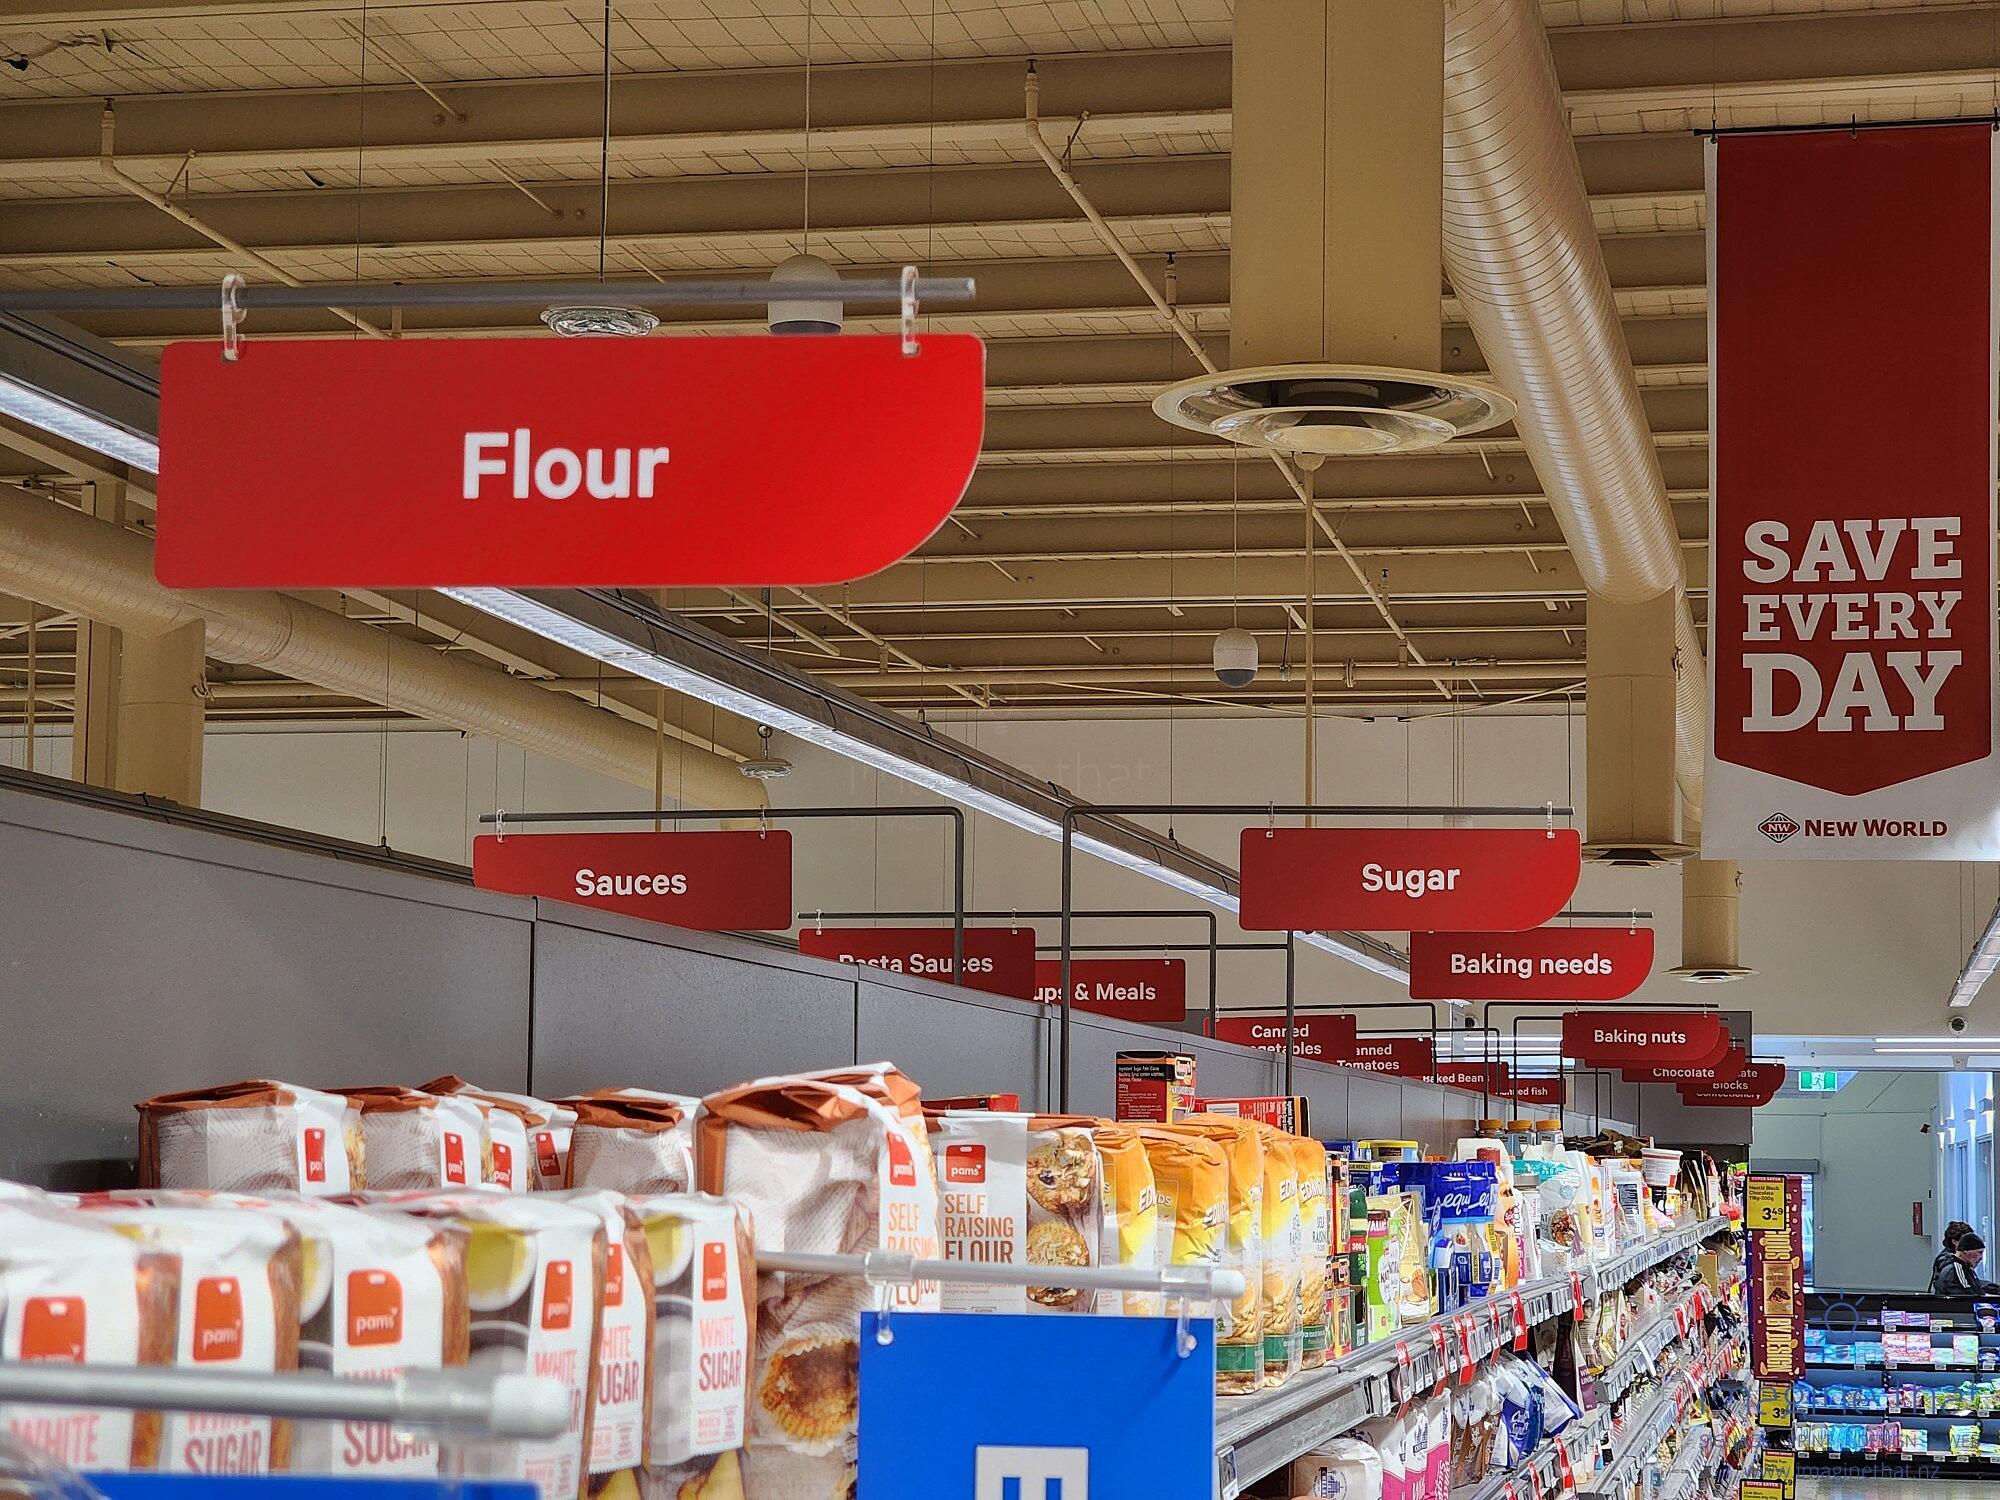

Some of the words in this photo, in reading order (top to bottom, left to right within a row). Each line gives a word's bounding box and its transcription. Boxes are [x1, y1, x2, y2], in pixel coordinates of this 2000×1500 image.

[463, 428, 670, 499] Flour
[1743, 517, 1962, 584] SAVE
[1742, 591, 1962, 641] EVERY
[1742, 650, 1962, 732] DAY
[1767, 822, 1792, 833] NW
[1804, 819, 1858, 837] NEW
[1862, 819, 1948, 837] WORLD
[575, 868, 687, 896] Sauces
[1362, 863, 1460, 898] Sugar
[839, 954, 903, 973] Psta
[1451, 953, 1532, 979] Baking
[1540, 953, 1613, 976] needs
[1074, 983, 1089, 1000] &
[1096, 982, 1156, 1000] Meals
[1355, 1043, 1392, 1056] anned
[1594, 1029, 1647, 1046] Baking
[1651, 1030, 1686, 1043] nuts
[1458, 1073, 1490, 1083] Bean
[1653, 1068, 1715, 1078] Chocolate
[1531, 1087, 1548, 1096] fish
[951, 1164, 979, 1177] pams
[944, 1193, 986, 1214] SELF
[887, 1202, 919, 1232] SELF
[945, 1216, 1014, 1238] RAISING
[945, 1240, 1014, 1264] FLOUR
[600, 1325, 632, 1360] HITE
[700, 1317, 736, 1348] WHITE
[1766, 1333, 1793, 1373] DESIGN
[599, 1361, 640, 1405] UGAR
[699, 1350, 741, 1392] SUGAR
[184, 1430, 262, 1474] SUGAR
